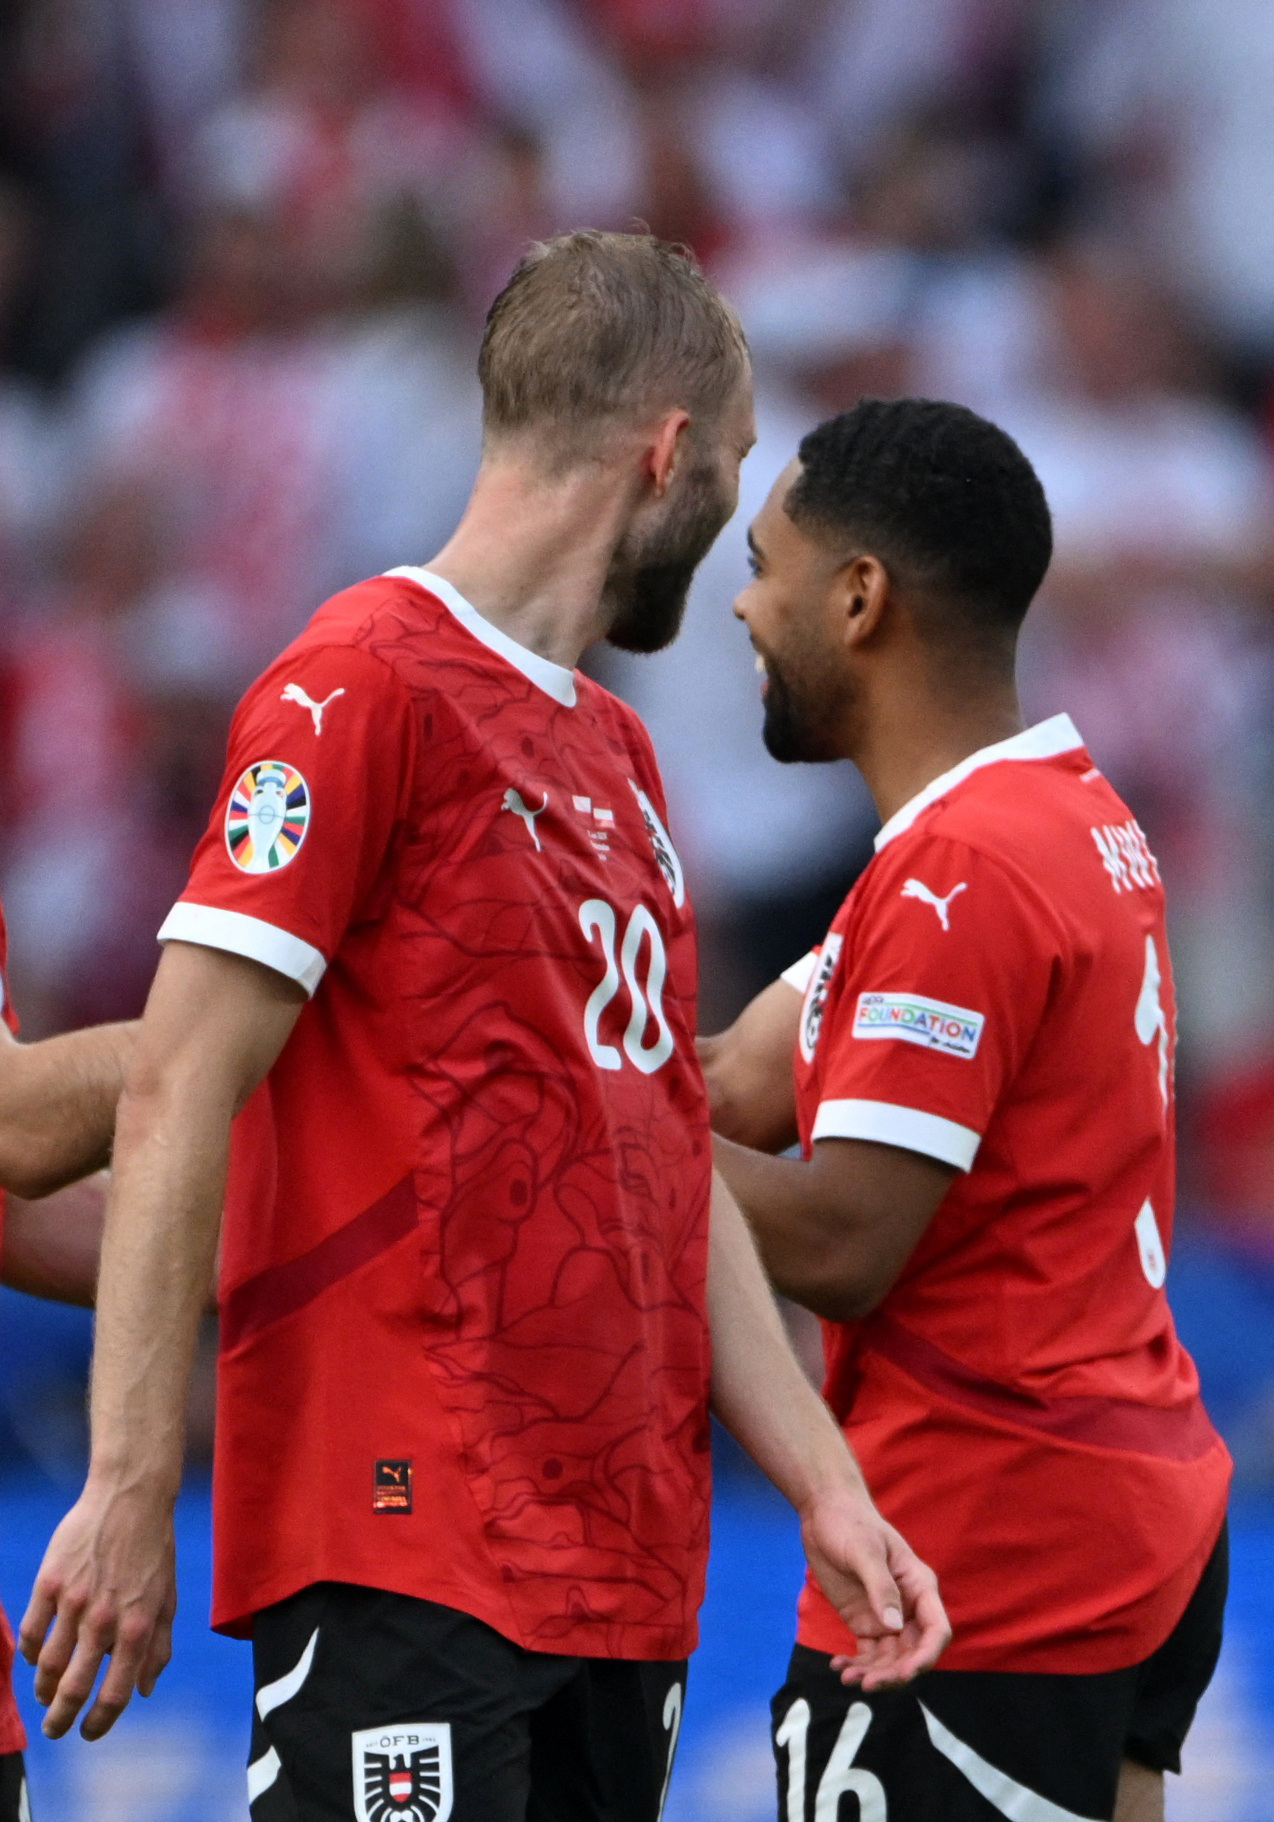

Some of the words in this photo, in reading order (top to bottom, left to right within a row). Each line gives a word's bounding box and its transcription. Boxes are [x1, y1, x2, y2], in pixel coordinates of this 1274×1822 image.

[578, 899, 674, 1074] 20
[859, 1007, 977, 1043] FOUNDATION
[776, 1698, 888, 1822] 16
